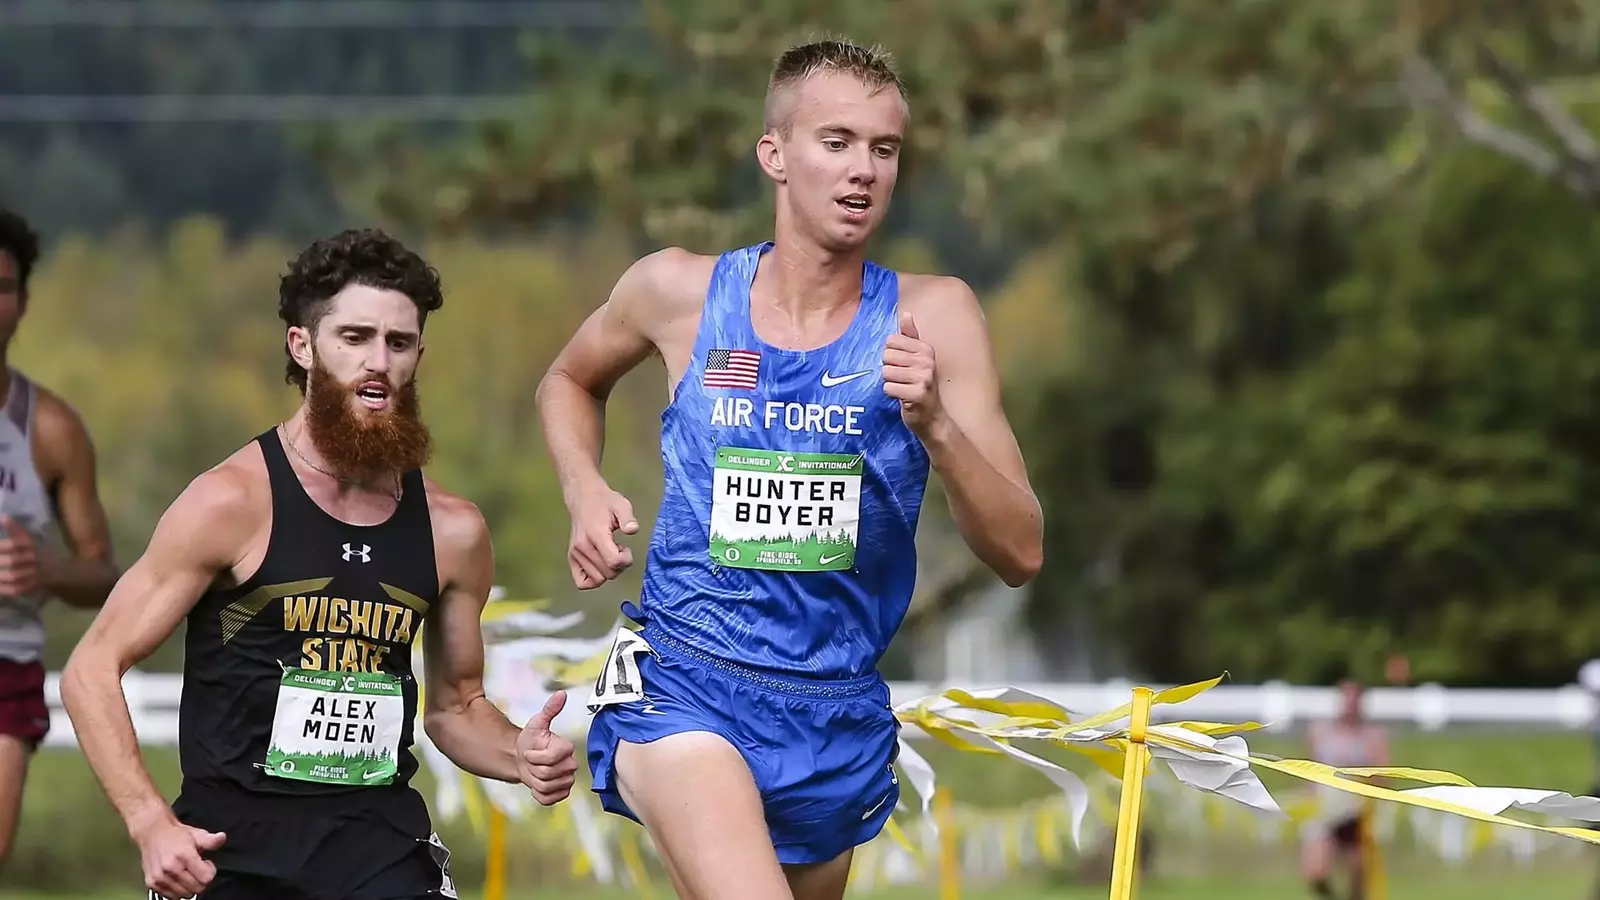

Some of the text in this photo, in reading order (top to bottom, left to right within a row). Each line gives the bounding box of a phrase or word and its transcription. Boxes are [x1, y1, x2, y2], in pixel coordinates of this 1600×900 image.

[710, 396, 865, 435] AIR FORCE
[727, 455, 852, 472] DELLINGER XC INVITATIONAL
[726, 475, 846, 501] HUNTER
[735, 502, 834, 526] BOYER
[283, 596, 414, 644] WICHITA
[300, 637, 391, 674] STATE
[294, 675, 337, 687] DELLINGER
[340, 676, 355, 691] XC
[310, 697, 377, 720] ALEX
[302, 719, 376, 743] MOEN
